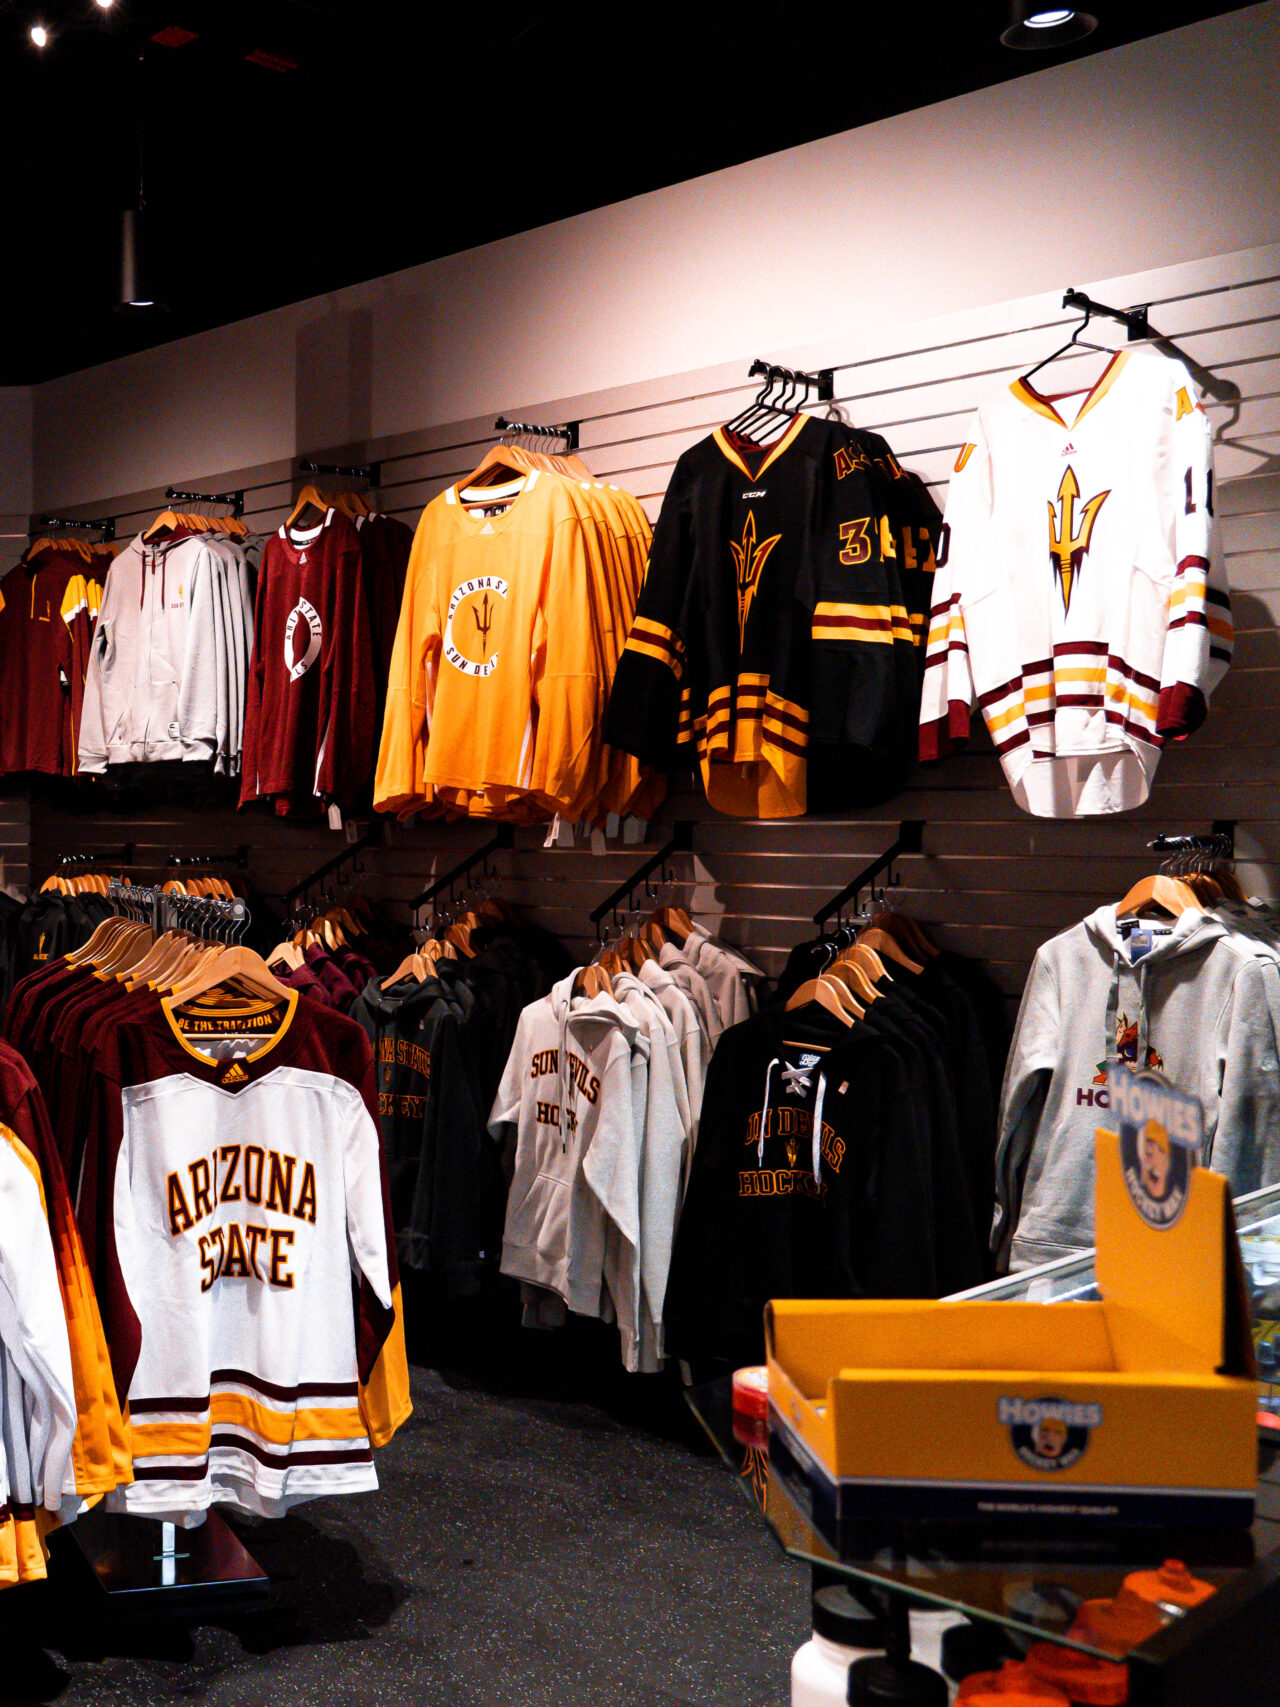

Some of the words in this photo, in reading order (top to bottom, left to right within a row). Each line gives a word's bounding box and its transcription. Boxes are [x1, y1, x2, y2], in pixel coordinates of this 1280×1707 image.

[742, 490, 767, 499] CCM
[300, 600, 323, 638] STATE
[446, 647, 468, 671] SUN
[177, 1018, 190, 1030] BE
[193, 1020, 214, 1031] THE
[221, 1074, 249, 1084] adidas
[531, 1048, 559, 1080] SUN
[565, 1049, 602, 1107] EVILS
[166, 1143, 318, 1238] ARIZONA
[197, 1222, 296, 1294] STATE
